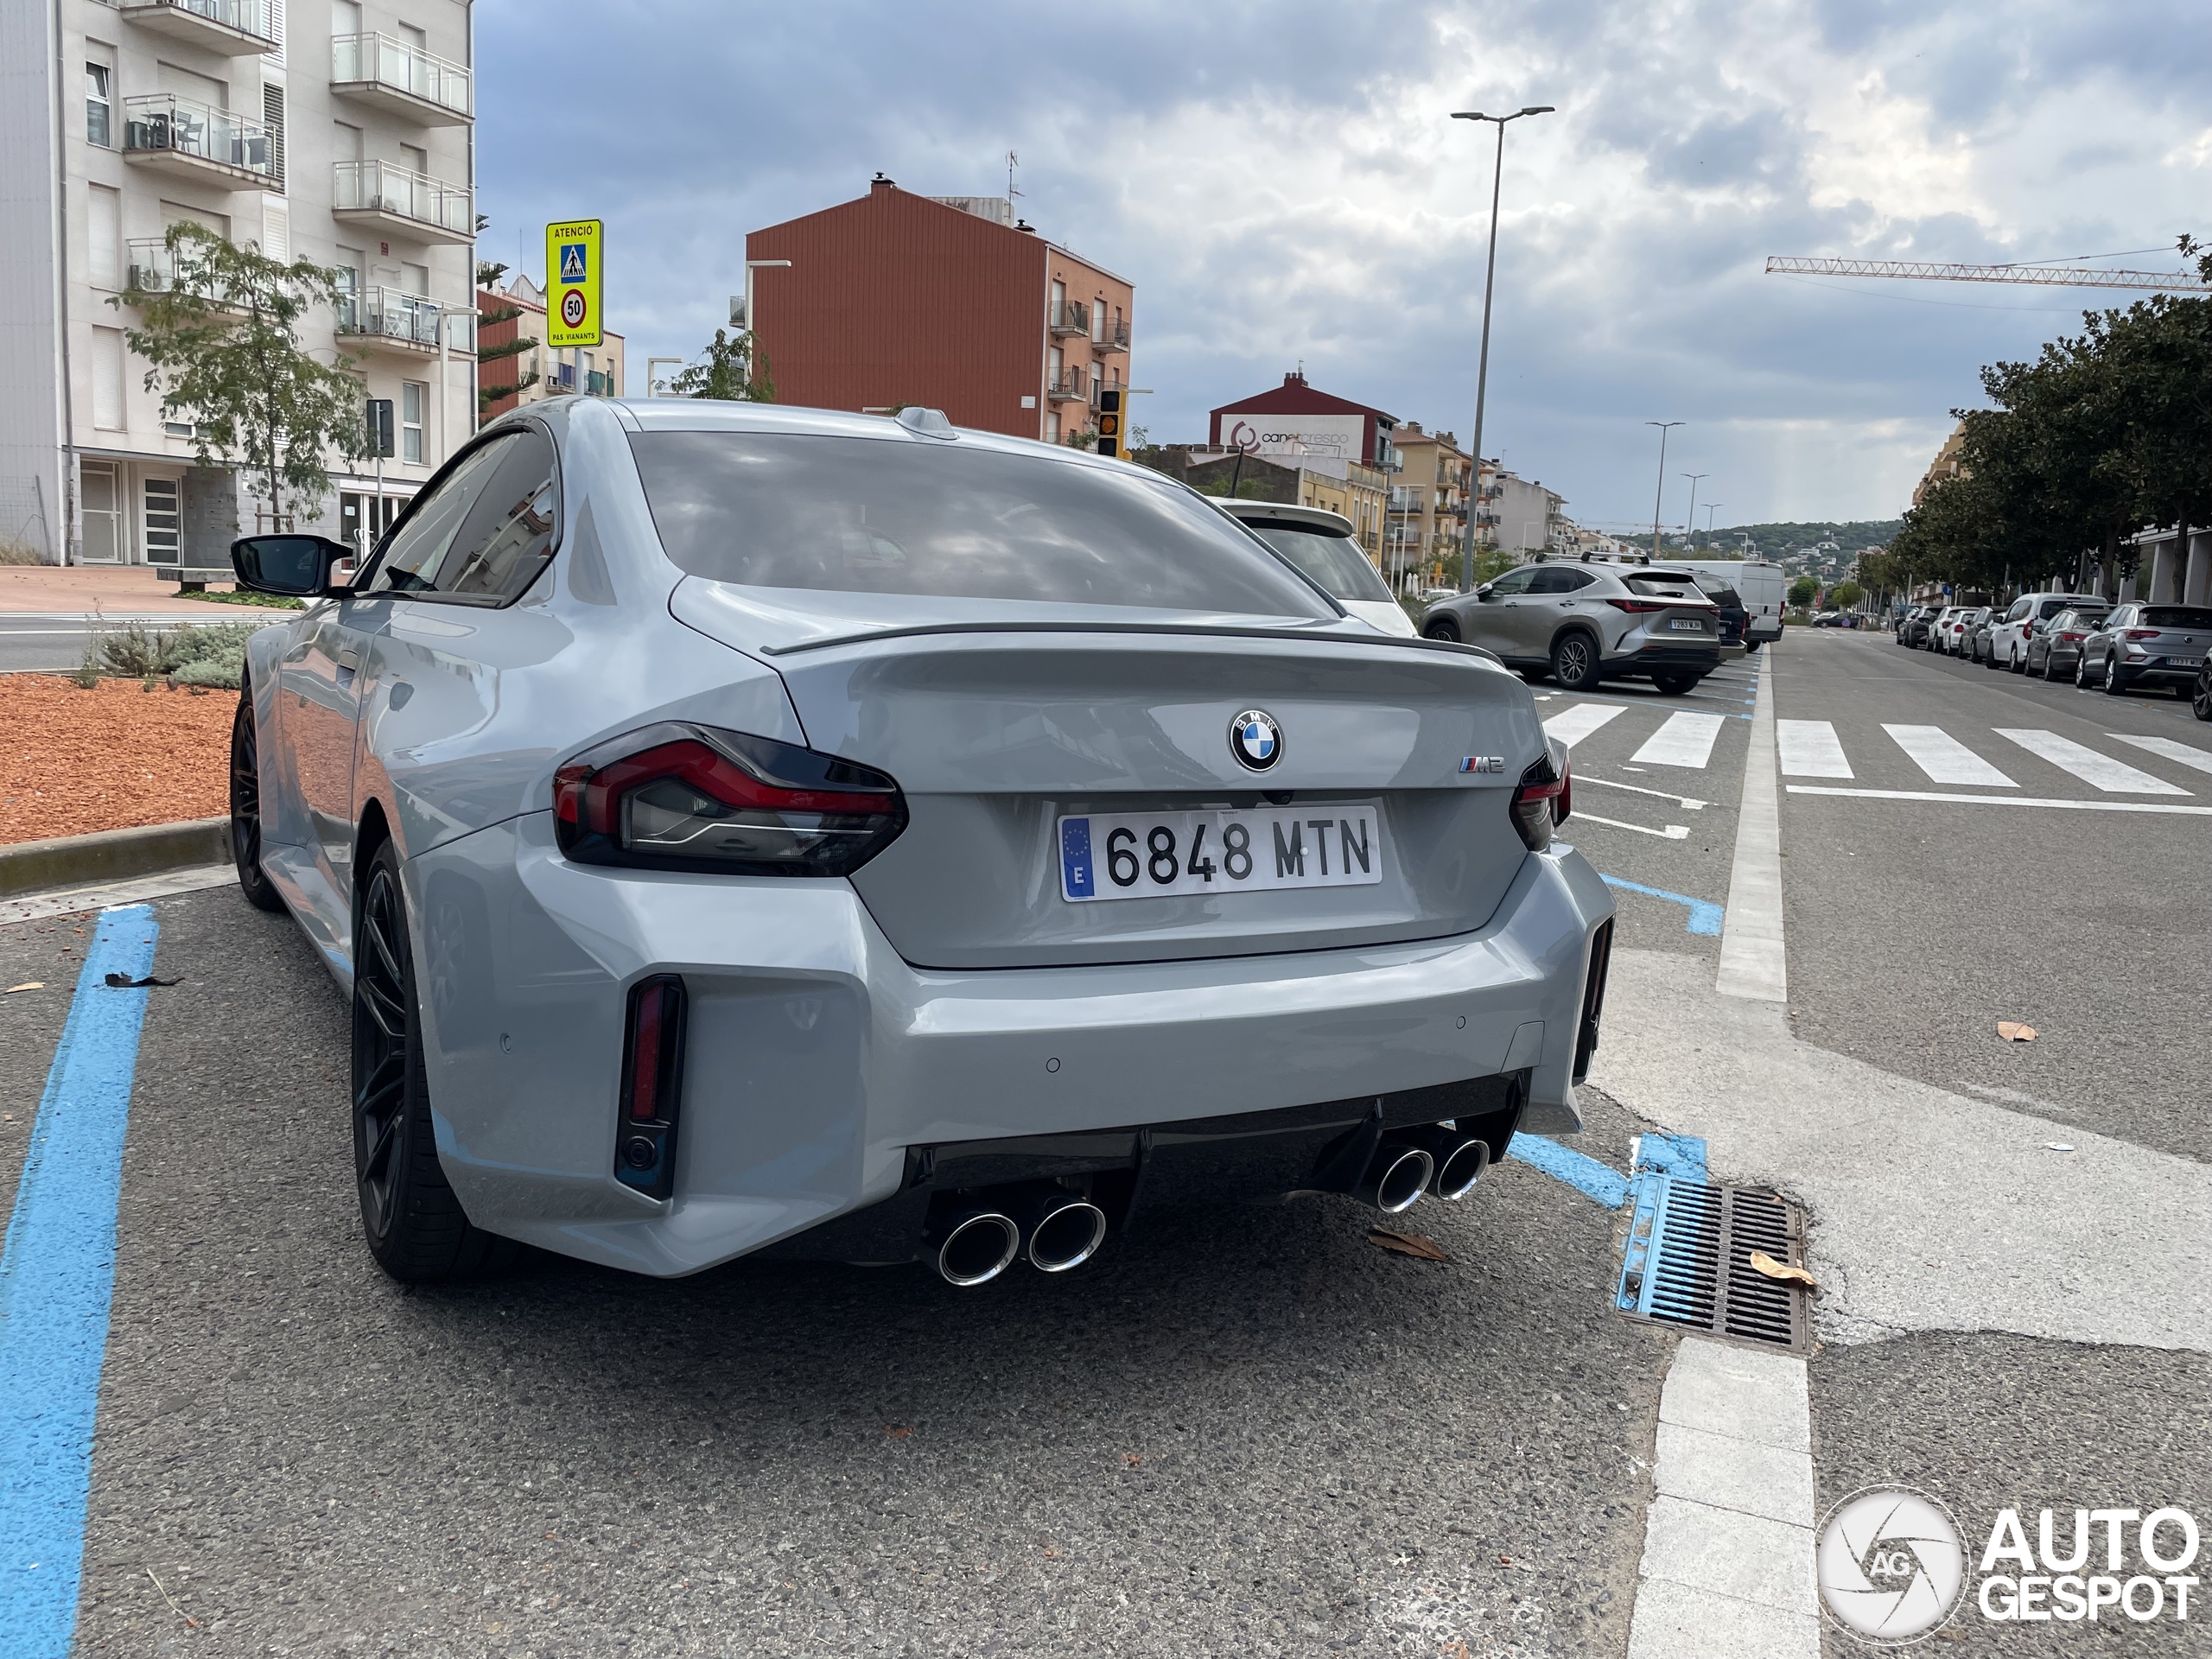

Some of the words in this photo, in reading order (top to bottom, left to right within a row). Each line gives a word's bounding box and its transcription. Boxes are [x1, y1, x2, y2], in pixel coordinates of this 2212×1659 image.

[554, 224, 593, 238] ATENCIÓ
[567, 300, 581, 317] 50
[566, 332, 595, 340] VIANANTS
[1236, 713, 1276, 731] BMW
[1474, 756, 1506, 772] M2
[1106, 823, 1253, 887] 6848
[1272, 819, 1370, 879] MTN
[1073, 867, 1084, 884] E
